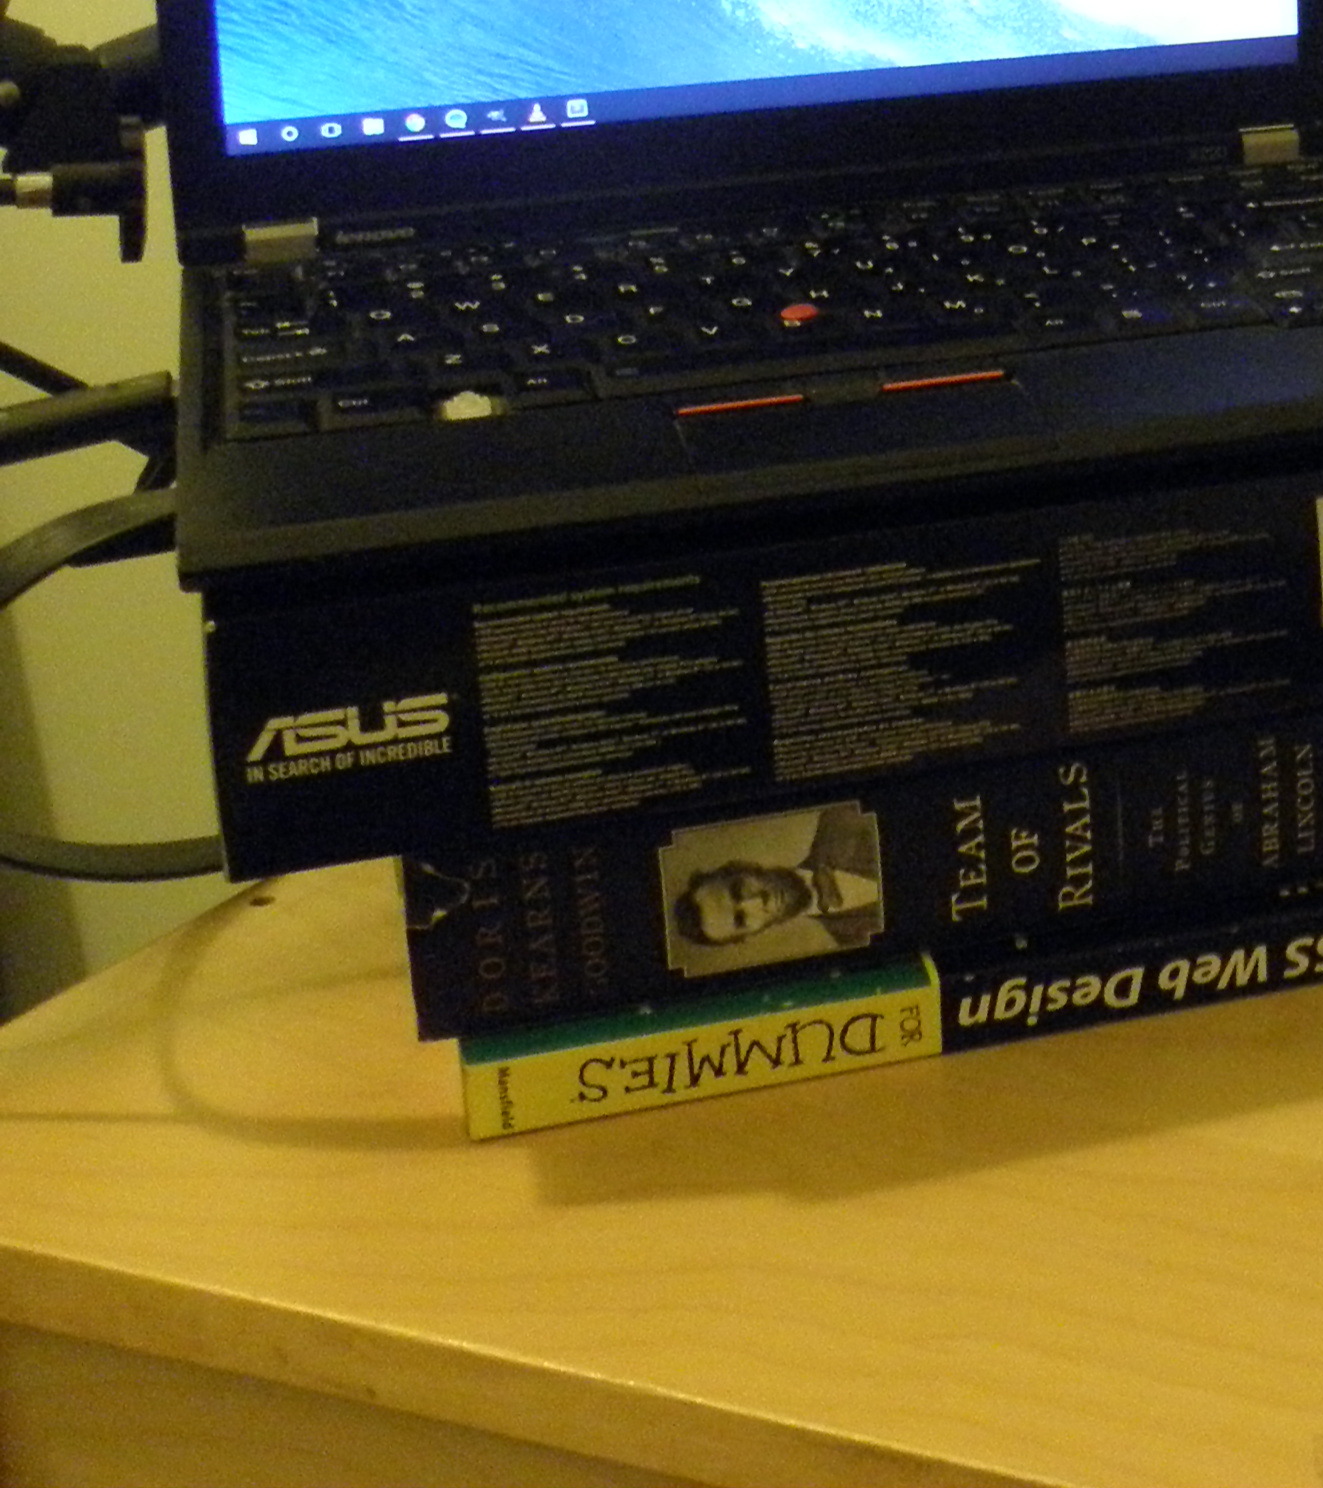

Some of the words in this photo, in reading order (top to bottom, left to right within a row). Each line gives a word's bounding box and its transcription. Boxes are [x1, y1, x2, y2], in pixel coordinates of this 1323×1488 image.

[246, 765, 265, 784] IN
[268, 753, 332, 782] SEARCH
[334, 751, 355, 770] OF
[358, 735, 453, 767] INCREDIBLE
[247, 691, 451, 763] ASUS
[1058, 761, 1094, 912] RIVALS
[1174, 769, 1191, 874] POLITICAL
[1256, 735, 1280, 869] ABRAHAM
[1294, 742, 1317, 855] LINCOLN
[951, 794, 989, 922] TEAM
[1010, 827, 1041, 875] OF
[572, 845, 609, 986] OODWIN
[957, 963, 1144, 1029] Design
[1157, 944, 1269, 1002] Web
[575, 1010, 888, 1105] DUMMIES
[898, 1004, 924, 1048] FOR
